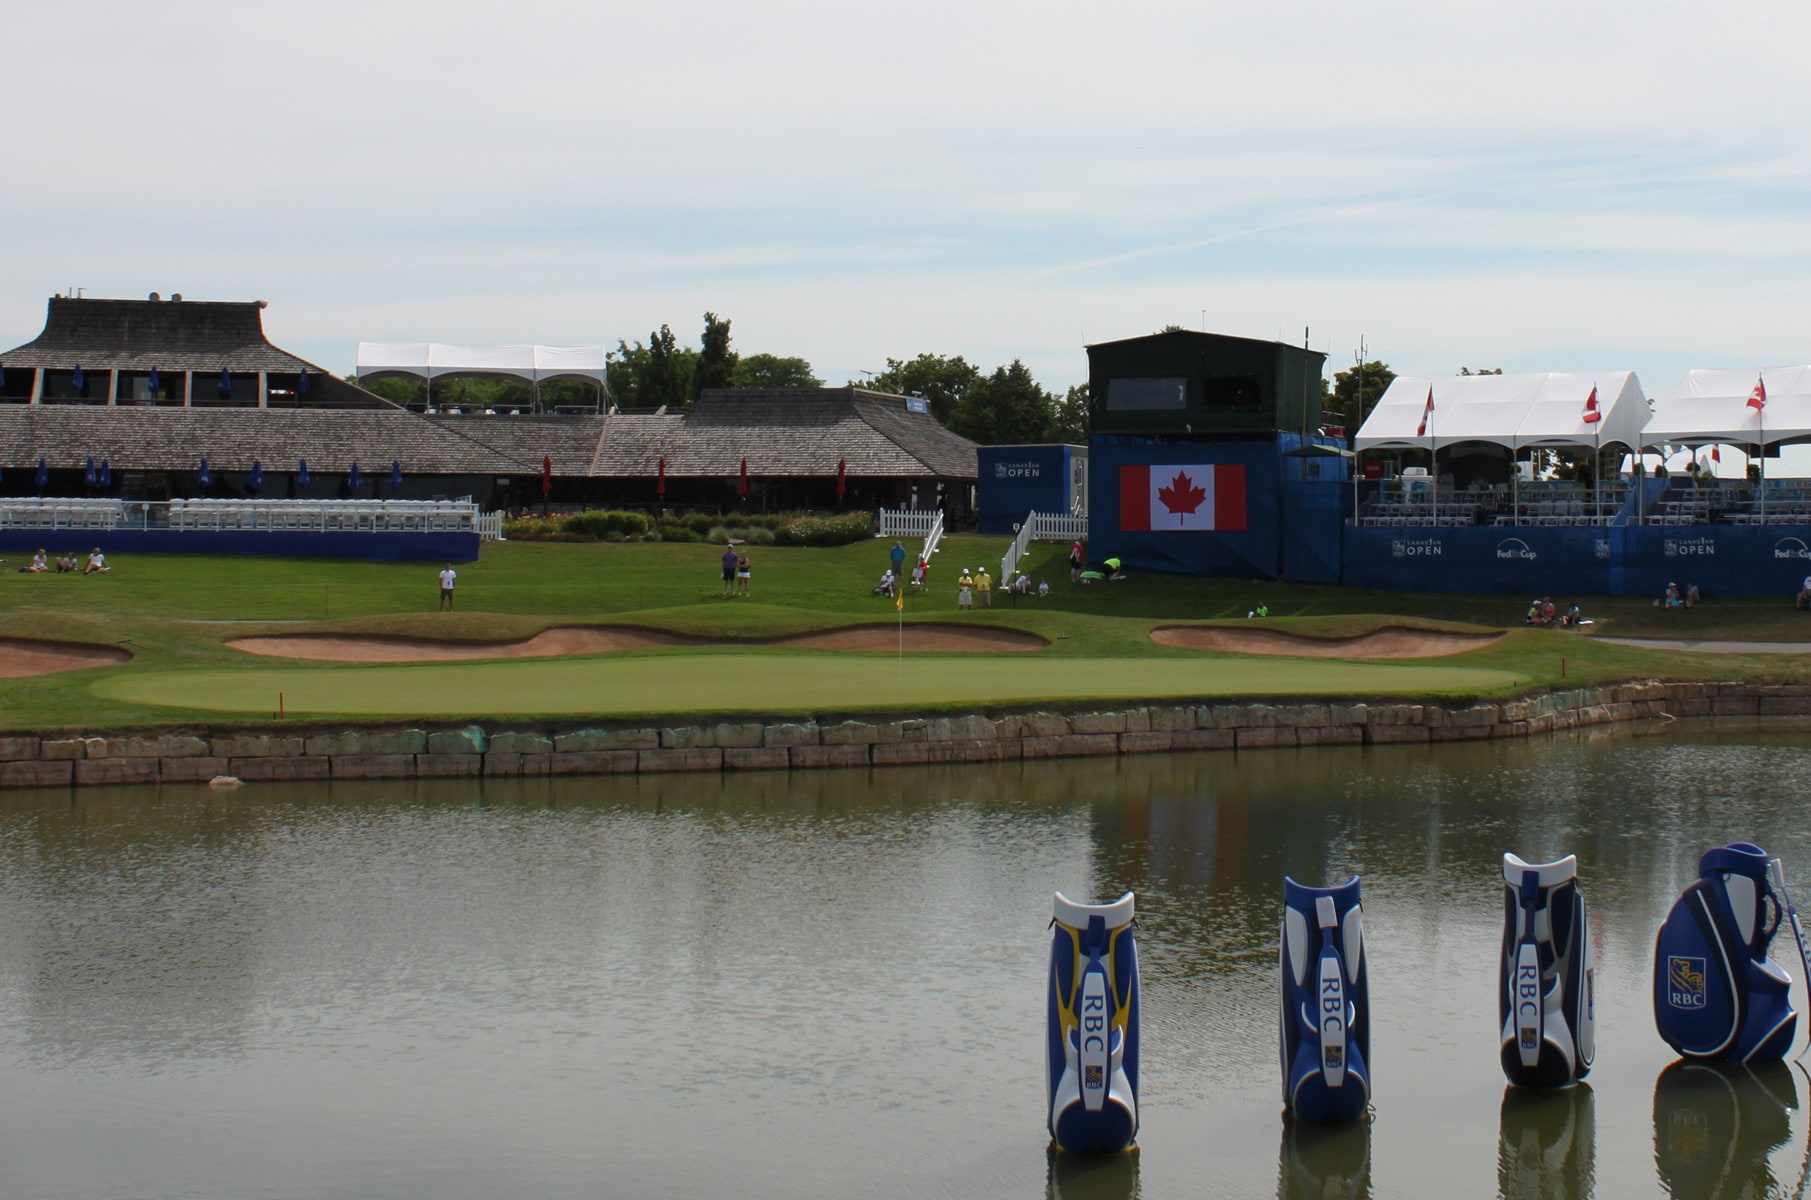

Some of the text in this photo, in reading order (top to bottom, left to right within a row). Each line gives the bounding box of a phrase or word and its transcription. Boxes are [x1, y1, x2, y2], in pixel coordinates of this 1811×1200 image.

[1008, 468, 1040, 477] OPEN
[1407, 546, 1442, 555] OPEN
[1679, 545, 1715, 555] OPEN
[1519, 965, 1537, 1017] RBC
[1322, 977, 1342, 1032] RBC
[1672, 992, 1703, 1006] RBC
[1085, 994, 1104, 1053] RBC
